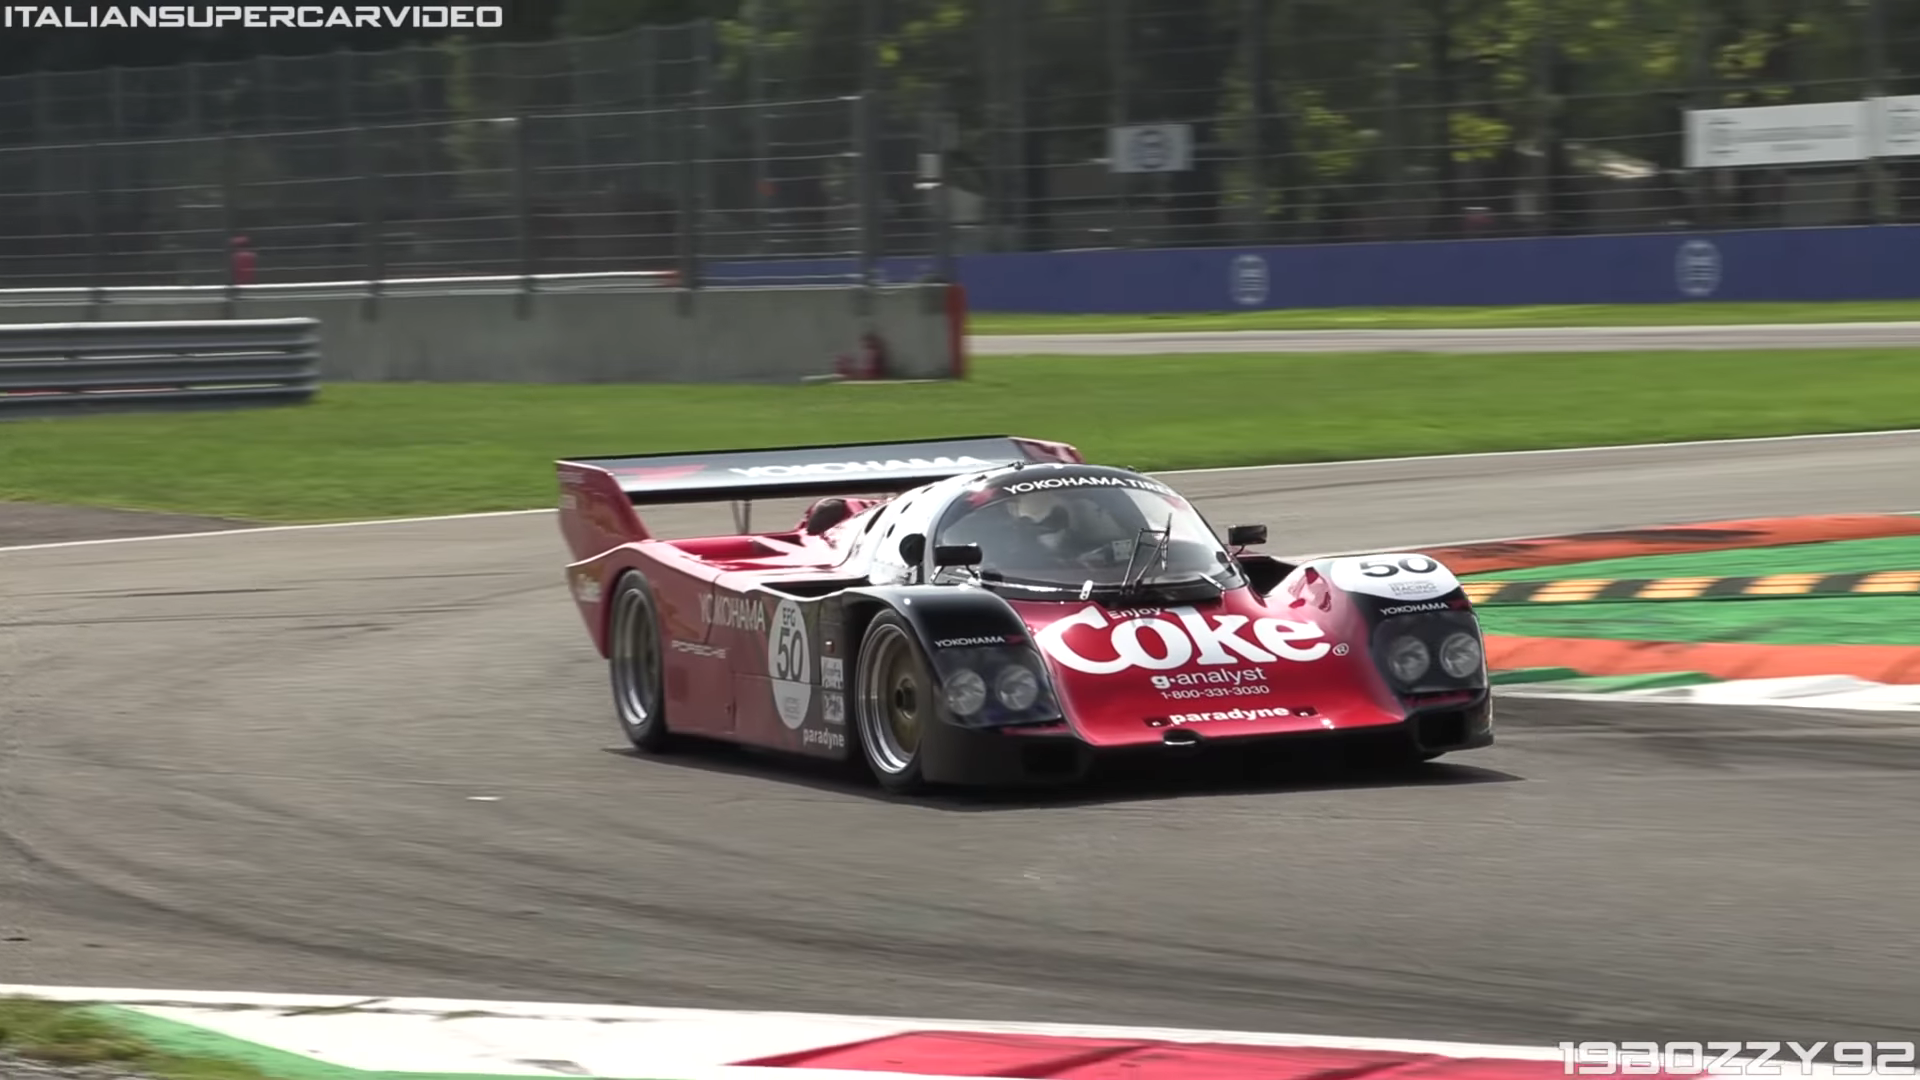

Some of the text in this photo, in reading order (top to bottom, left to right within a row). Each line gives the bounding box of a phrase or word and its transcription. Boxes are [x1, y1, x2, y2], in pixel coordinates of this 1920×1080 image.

[729, 455, 991, 478] YOKOHAMA
[1003, 477, 1126, 494] YOKOHAMA
[1359, 558, 1438, 578] 50
[698, 593, 766, 632] YOKOHAMA
[782, 607, 796, 627] EFG
[1108, 606, 1162, 620] Enjoy
[1380, 602, 1449, 616] YOKOHAMA
[672, 640, 727, 659] PORSCHE
[935, 636, 1005, 647] YOKOHAMA
[1033, 605, 1331, 675] Coke
[776, 626, 804, 680] 50
[1161, 685, 1270, 700] 1-800-331-3030
[1170, 707, 1290, 726] paradyne
[803, 727, 845, 750] paradyne
